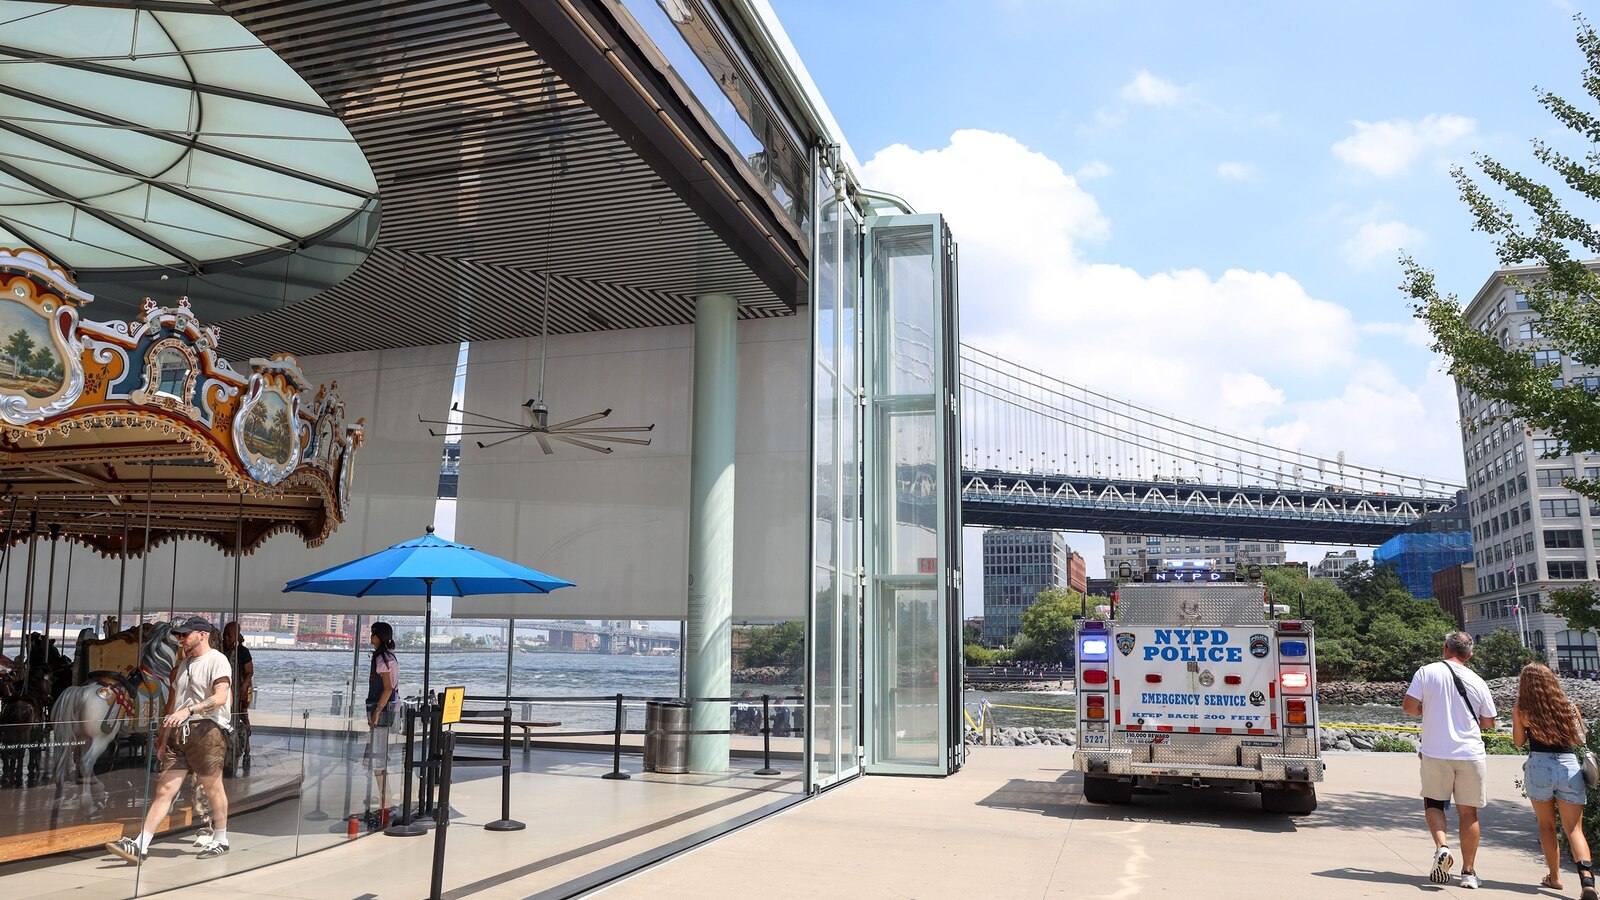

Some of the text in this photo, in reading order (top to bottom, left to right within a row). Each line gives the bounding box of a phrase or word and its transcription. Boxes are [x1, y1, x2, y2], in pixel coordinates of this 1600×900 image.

[920, 559, 936, 573] EXI
[1154, 629, 1229, 646] NYPD
[1143, 646, 1242, 662] POLICE
[1141, 692, 1246, 707] EMERGENCY SERVICE
[1084, 735, 1104, 743] 5727
